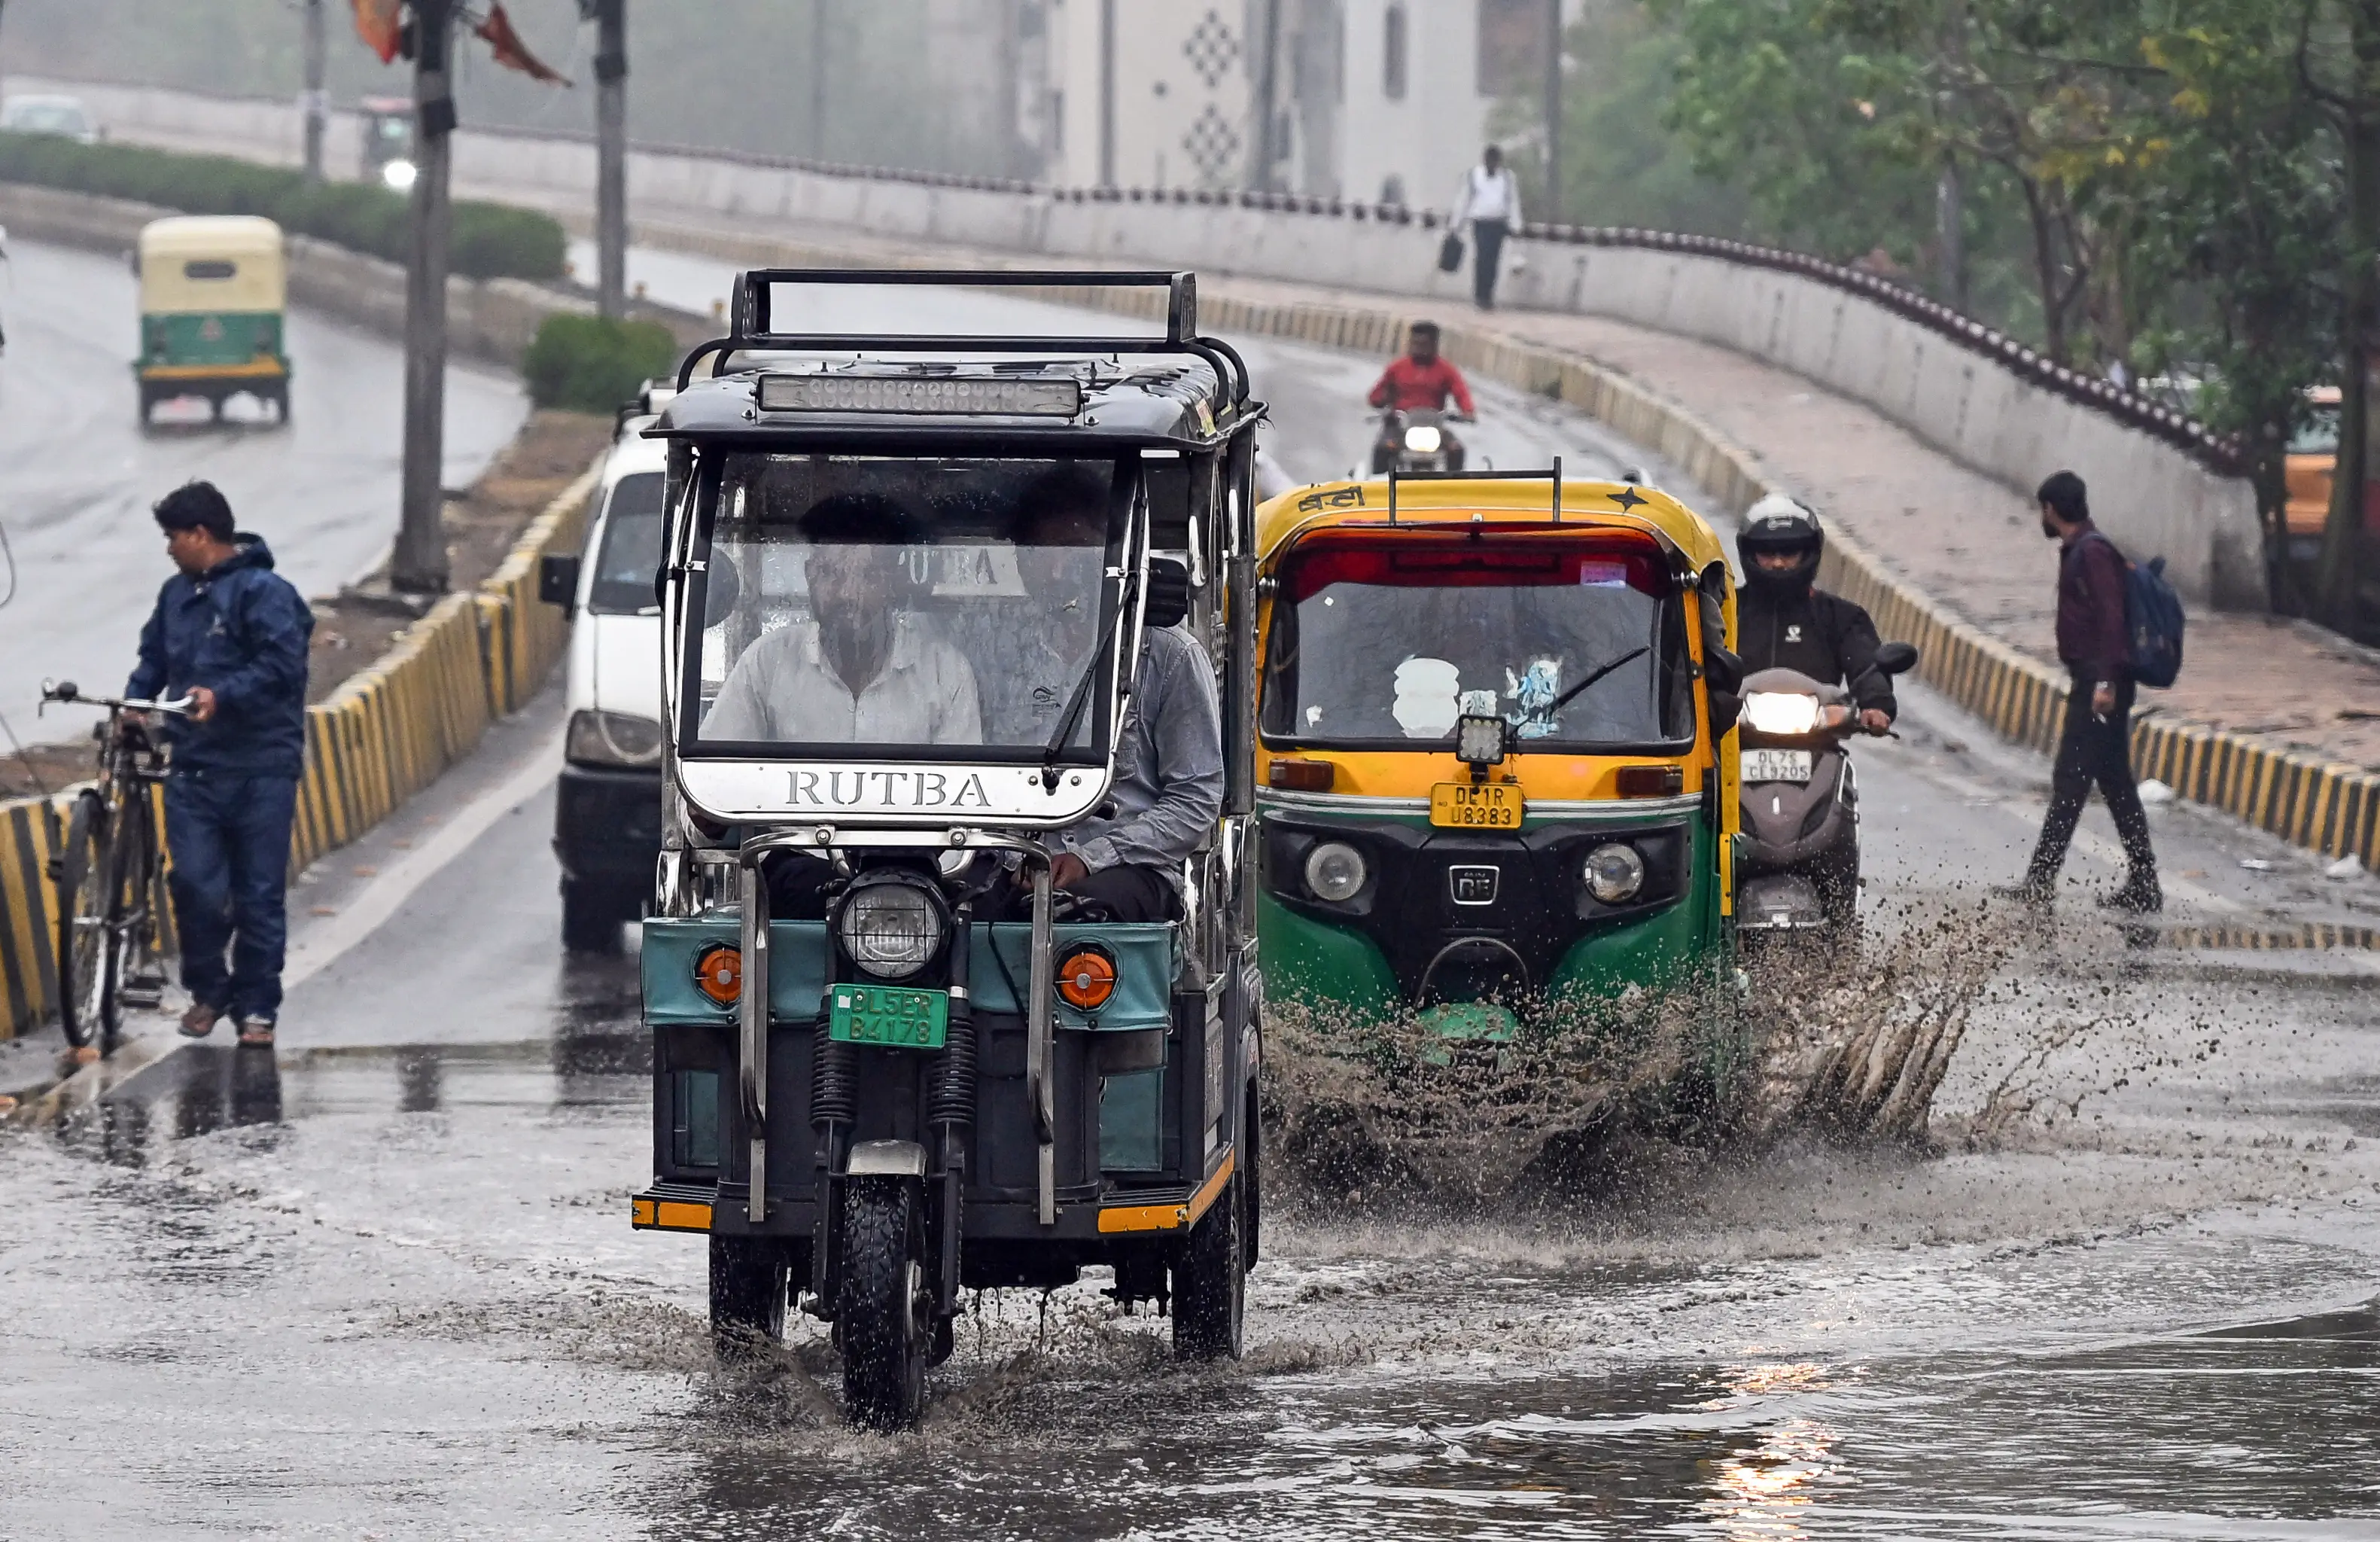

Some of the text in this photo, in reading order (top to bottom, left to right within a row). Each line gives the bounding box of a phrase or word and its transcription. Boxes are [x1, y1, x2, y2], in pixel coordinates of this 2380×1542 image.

[786, 771, 992, 806] RUTBA
[1456, 786, 1504, 806] DL1R
[1451, 806, 1512, 824] U8383
[852, 988, 933, 1017] DL5ER
[851, 1015, 932, 1044] B4178
